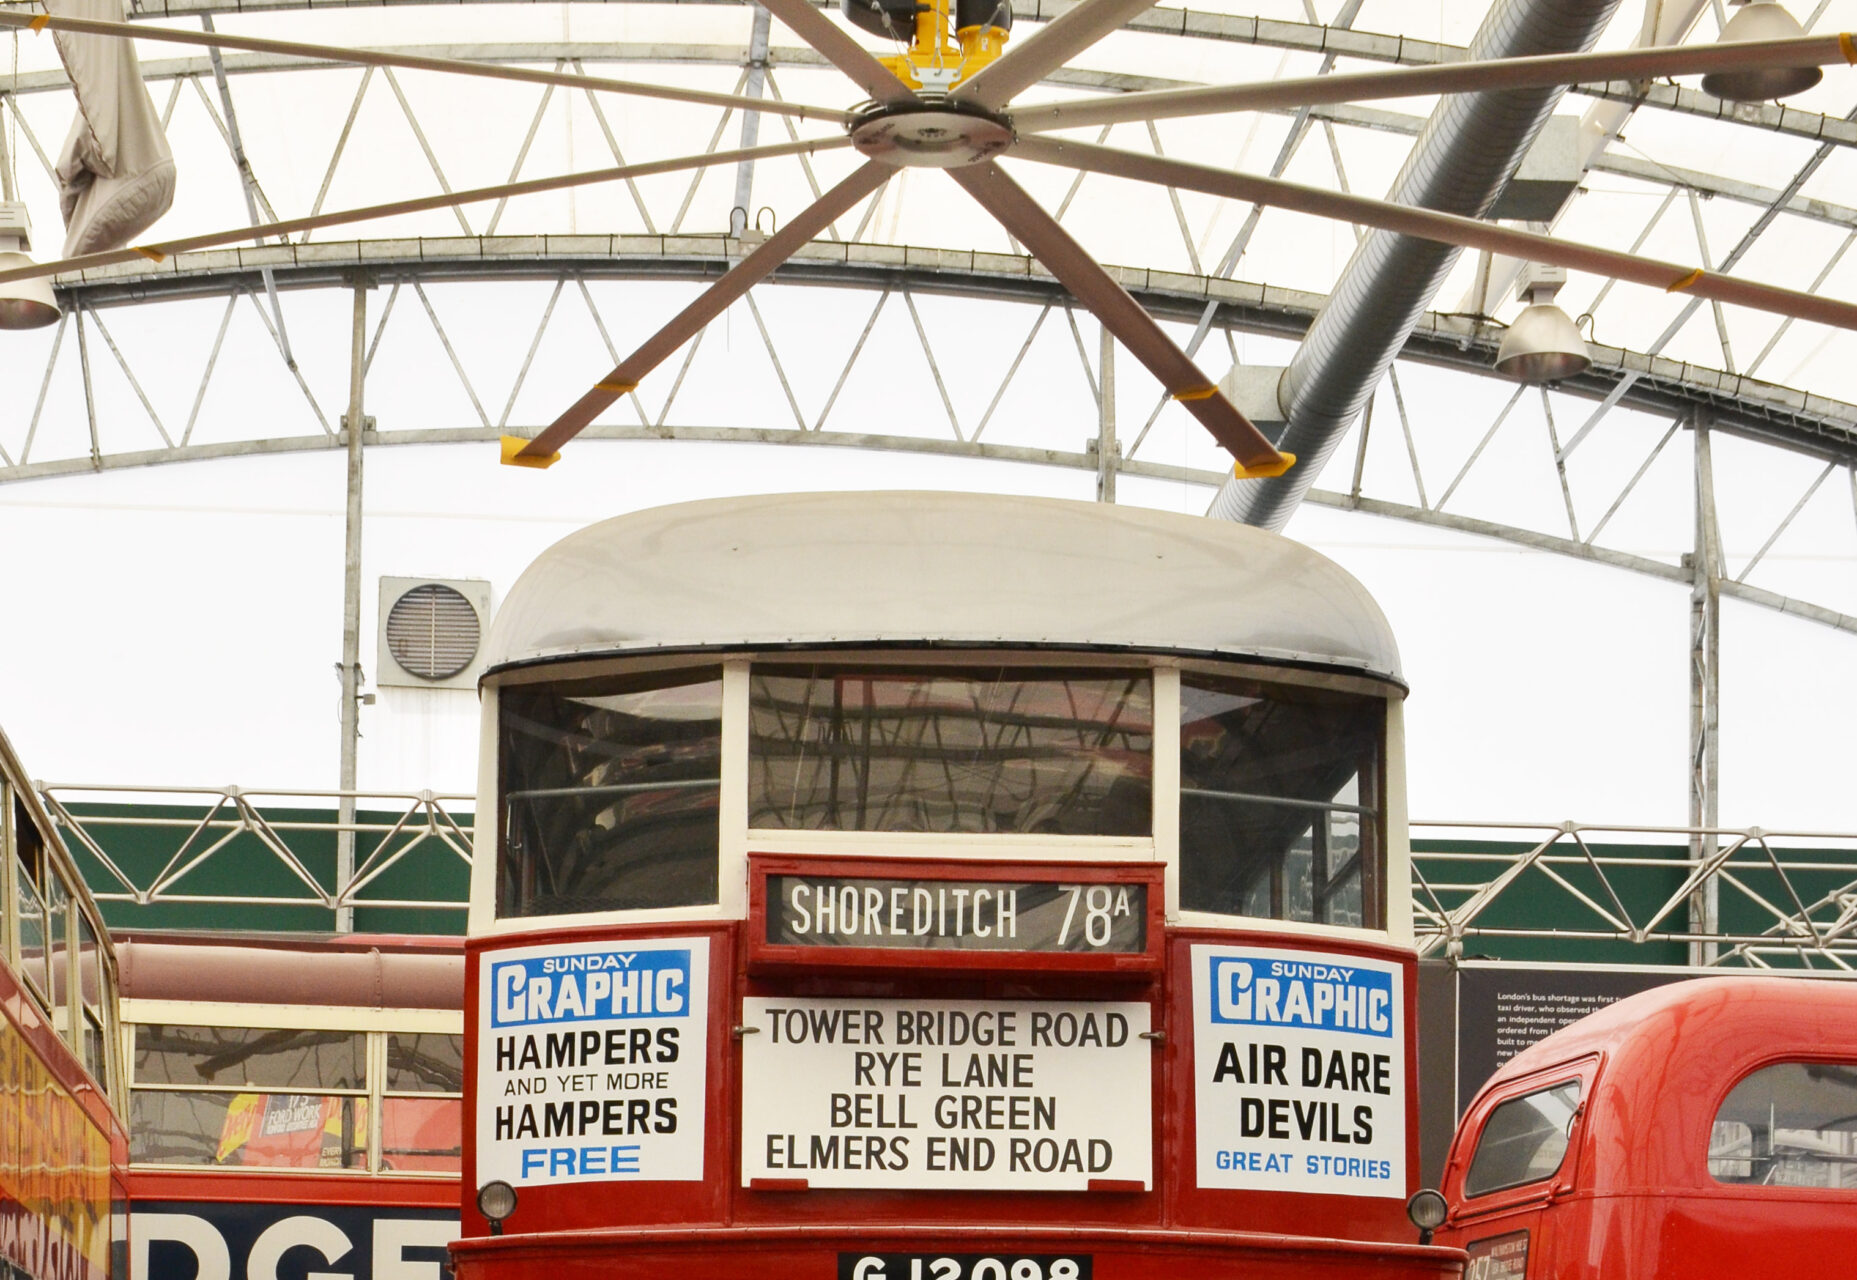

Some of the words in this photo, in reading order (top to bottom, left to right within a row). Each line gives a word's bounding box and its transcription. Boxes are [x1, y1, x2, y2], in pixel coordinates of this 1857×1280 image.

[791, 884, 1017, 938] SHOREDITCH
[1057, 885, 1130, 946] 78A
[543, 953, 637, 974] SUNDAY
[1271, 962, 1354, 982] SUNDAY
[497, 964, 683, 1023] GRAPHIC
[1218, 961, 1389, 1032] GRAPHIC
[1497, 993, 1531, 1001] London's
[1532, 993, 1546, 1002] bus
[1547, 994, 1580, 1004] shortage
[1581, 995, 1596, 1003] was
[1539, 1005, 1555, 1013] who
[1556, 1006, 1590, 1014] observed
[765, 1008, 884, 1045] TOWER
[896, 1010, 1017, 1047] BRIDGE
[1031, 1011, 1129, 1048] ROAD
[1497, 1027, 1527, 1035] ordered
[1509, 1016, 1556, 1025] independent
[496, 1027, 680, 1072] HAMPERS
[504, 1077, 547, 1096] AND
[557, 1074, 598, 1092] YET
[607, 1072, 669, 1090] MORE
[854, 1052, 922, 1087] RYE
[941, 1053, 1034, 1088] LANE
[1212, 1042, 1289, 1086] AIR
[1302, 1047, 1391, 1095] DARE
[496, 1098, 678, 1141] HAMPERS
[830, 1093, 918, 1129] BELL
[934, 1095, 1056, 1131] GREEN
[1241, 1097, 1373, 1145] DEVILS
[522, 1145, 641, 1179] FREE
[766, 1134, 910, 1171] ELMERS
[926, 1137, 996, 1172] END
[1009, 1138, 1113, 1173] ROAD
[1216, 1150, 1293, 1173] GREAT
[1307, 1155, 1391, 1179] STORIES
